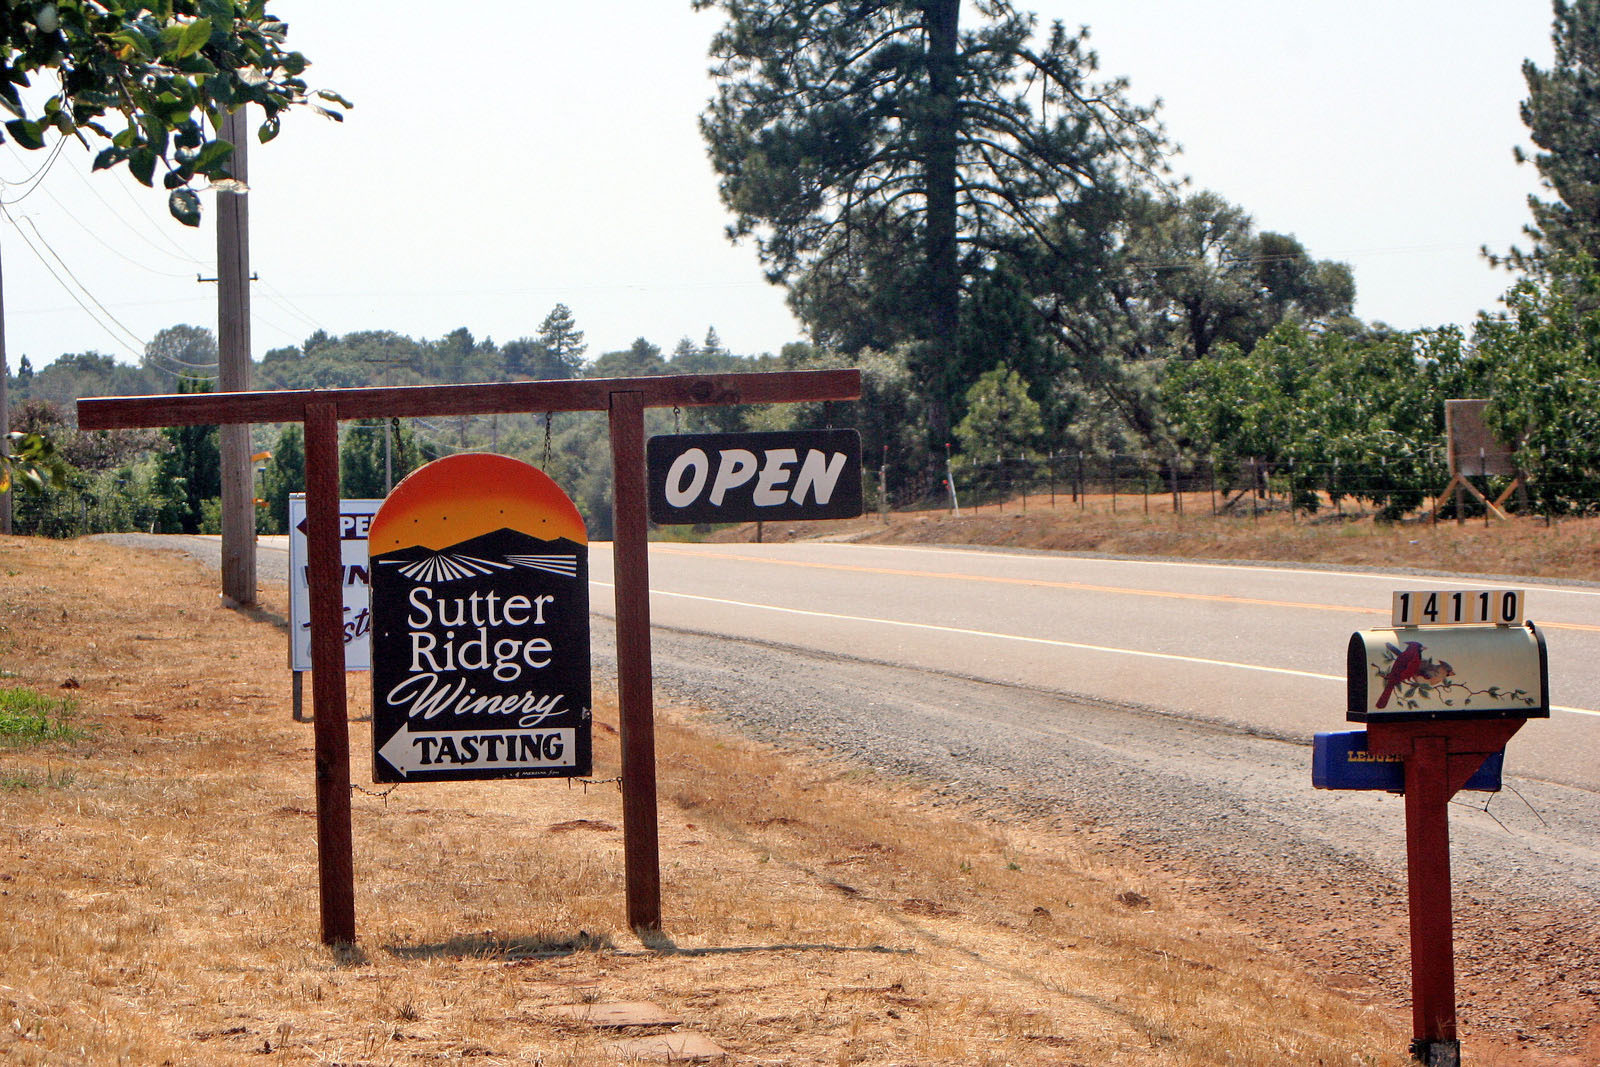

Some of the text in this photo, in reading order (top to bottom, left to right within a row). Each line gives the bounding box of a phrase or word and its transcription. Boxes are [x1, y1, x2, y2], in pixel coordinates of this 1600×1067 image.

[665, 448, 848, 508] OPEN
[340, 516, 371, 537] PE
[407, 586, 554, 629] Sutter
[1400, 591, 1517, 622] 14110
[409, 627, 553, 682] Ridge
[386, 672, 569, 727] Winery
[412, 732, 564, 765] TASTING
